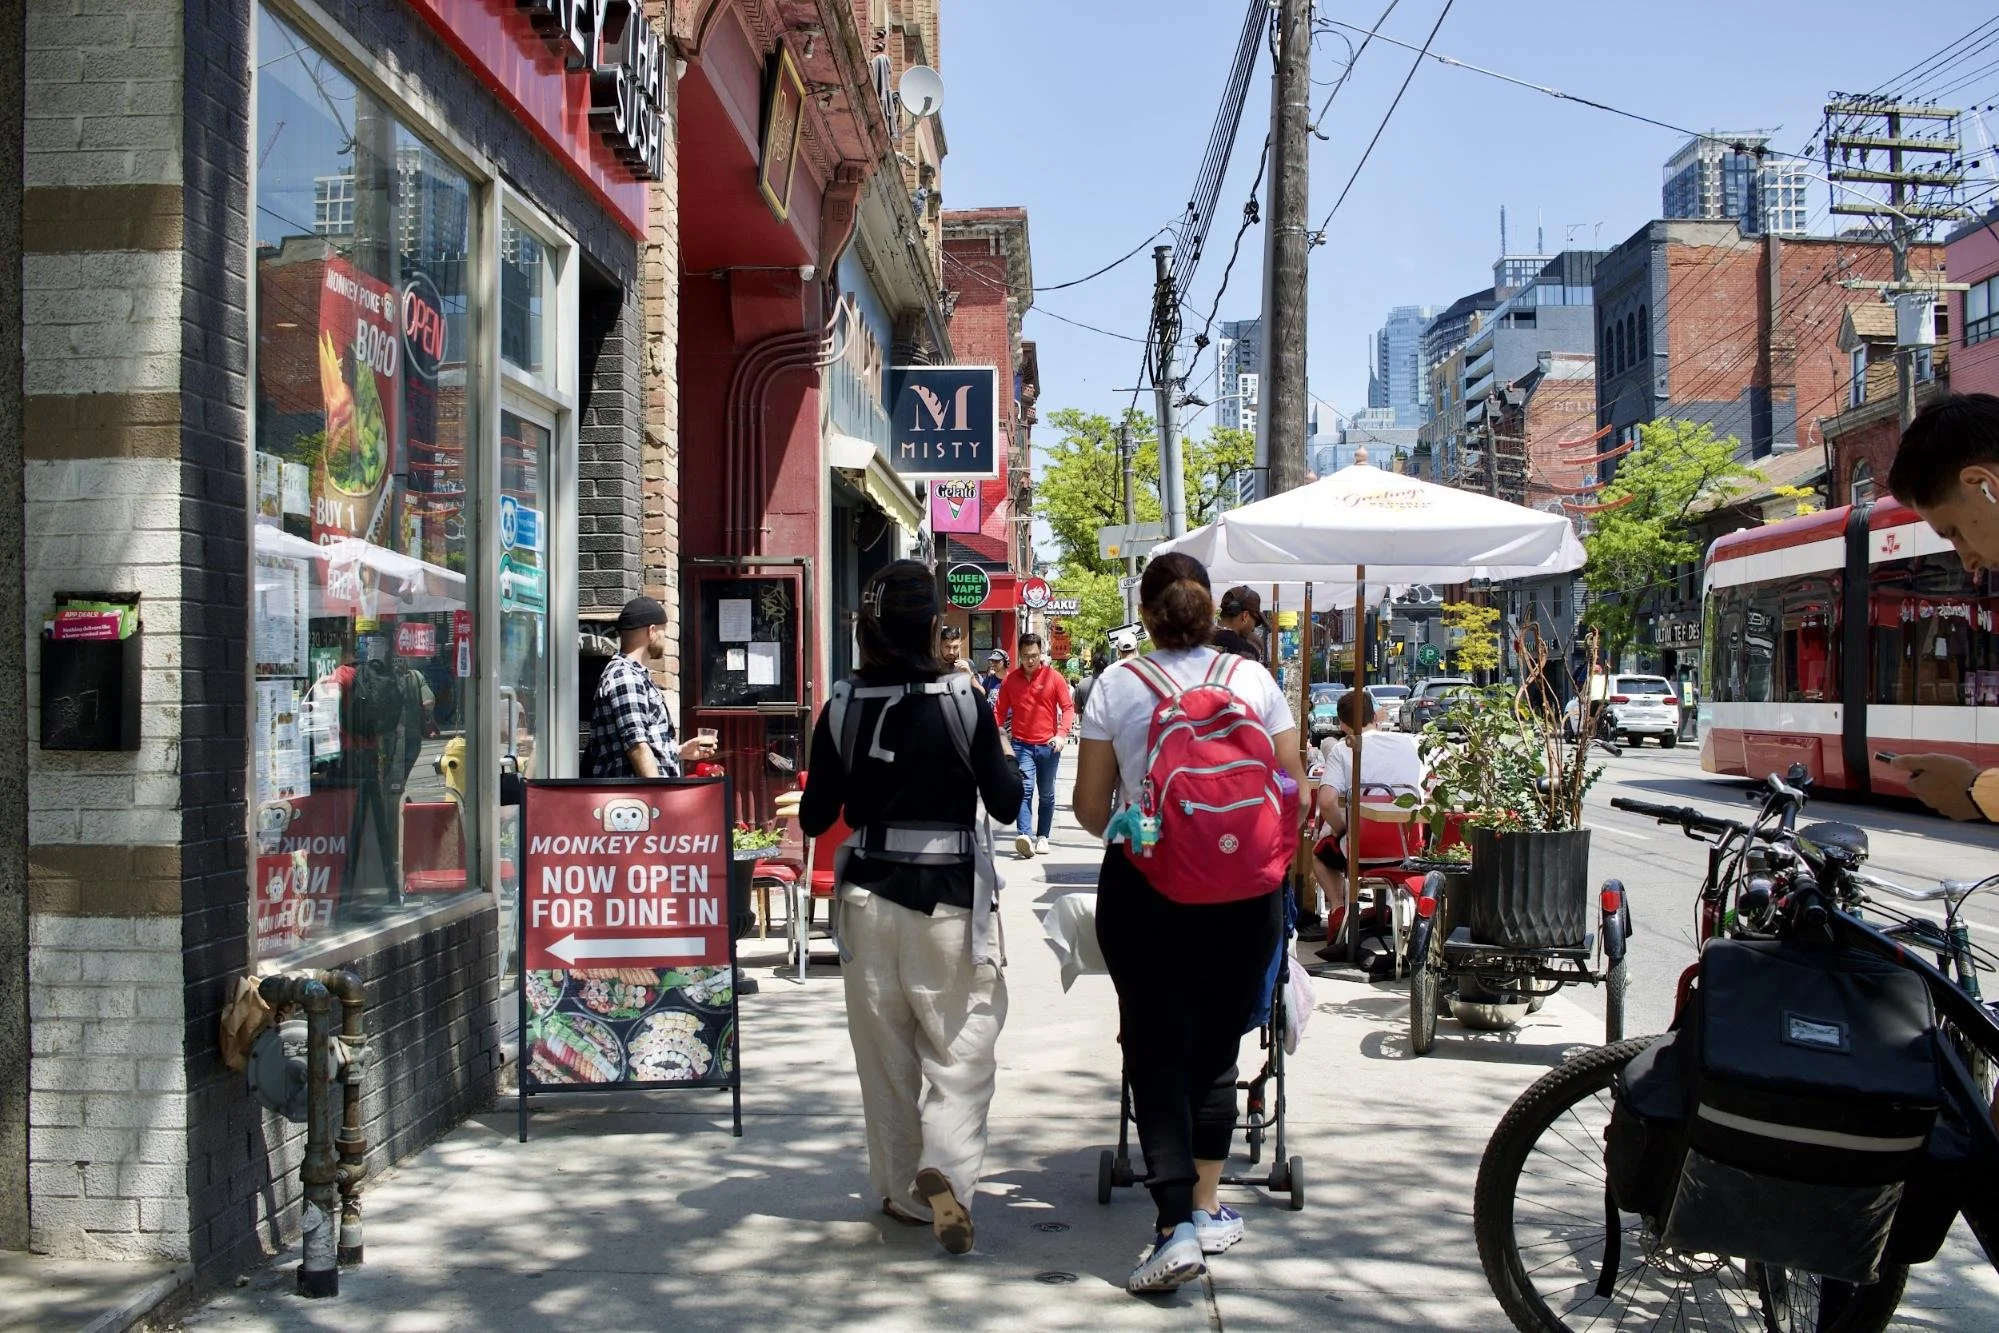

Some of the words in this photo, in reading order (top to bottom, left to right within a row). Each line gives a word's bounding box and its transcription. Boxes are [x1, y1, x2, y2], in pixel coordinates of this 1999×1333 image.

[615, 65, 666, 182] SUSHI
[326, 267, 358, 302] MONKEY
[359, 286, 380, 313] POKE
[405, 291, 446, 361] OPEN
[356, 318, 397, 377] BOGO
[901, 442, 982, 459] MISTY
[935, 482, 977, 499] Gelato
[316, 497, 343, 528] BUY
[347, 504, 356, 531] 1
[948, 573, 987, 583] QUEEN
[952, 584, 982, 594] VAPE
[952, 595, 982, 604] SHOP
[1047, 600, 1076, 609] SAKU
[529, 836, 640, 855] MONKEY
[642, 834, 719, 854] SUSHI
[542, 865, 617, 895] NOW
[627, 864, 708, 894] OPEN
[532, 898, 594, 928] FOR
[605, 898, 677, 927] DINE
[688, 897, 719, 926] IN
